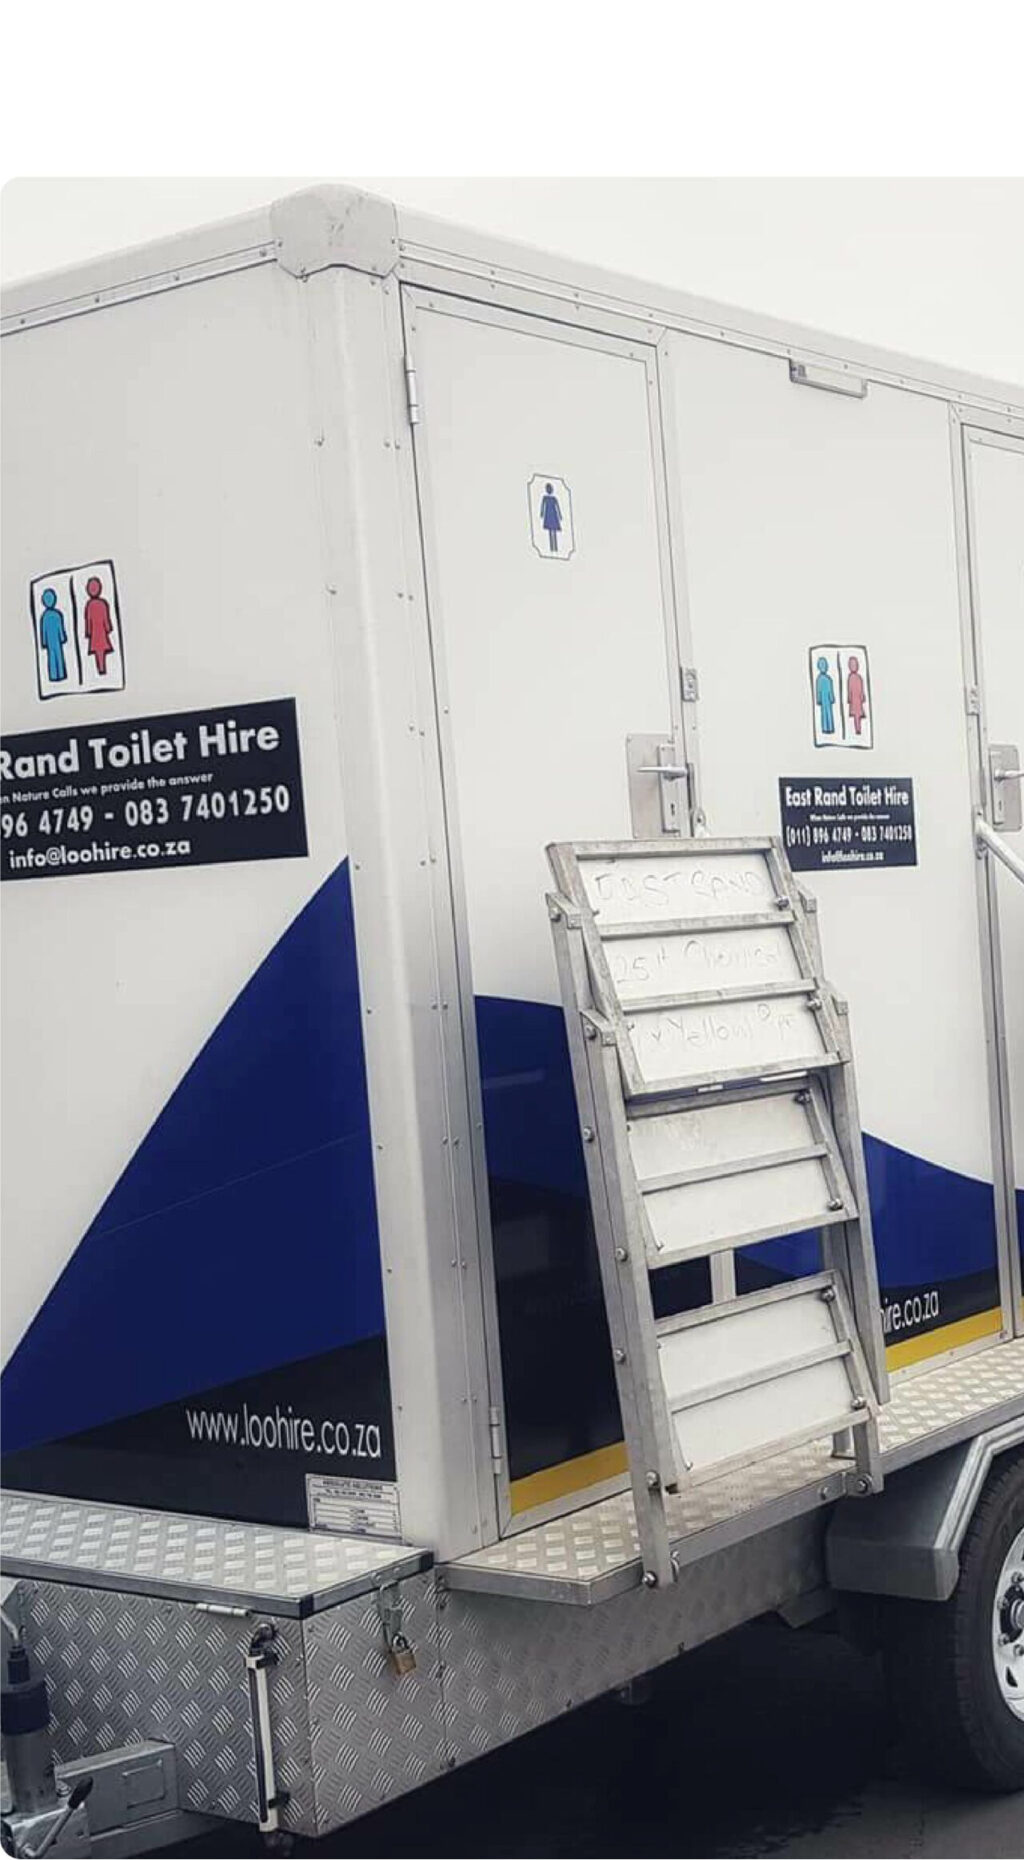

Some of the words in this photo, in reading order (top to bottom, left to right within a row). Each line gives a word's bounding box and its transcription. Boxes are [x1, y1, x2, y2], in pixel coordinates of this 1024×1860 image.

[0, 739, 79, 780] Rand
[88, 729, 188, 769] Toilet
[199, 720, 279, 757] Hire
[12, 791, 50, 803] Nature
[52, 786, 77, 799] Calls
[80, 785, 97, 795] we
[101, 778, 144, 796] provide
[147, 774, 166, 789] the
[168, 773, 214, 786] answer
[785, 786, 811, 807] East
[814, 784, 847, 807] Rand
[848, 784, 881, 806] Toilet
[884, 785, 909, 806] Hire
[1, 811, 28, 838] 96
[38, 805, 93, 835] 4749
[125, 798, 169, 827] 083
[181, 785, 290, 822] 7401250
[786, 824, 811, 847] (011)
[9, 840, 191, 869] info@loohire.co.za
[186, 1403, 381, 1458] www.loohire.co.za
